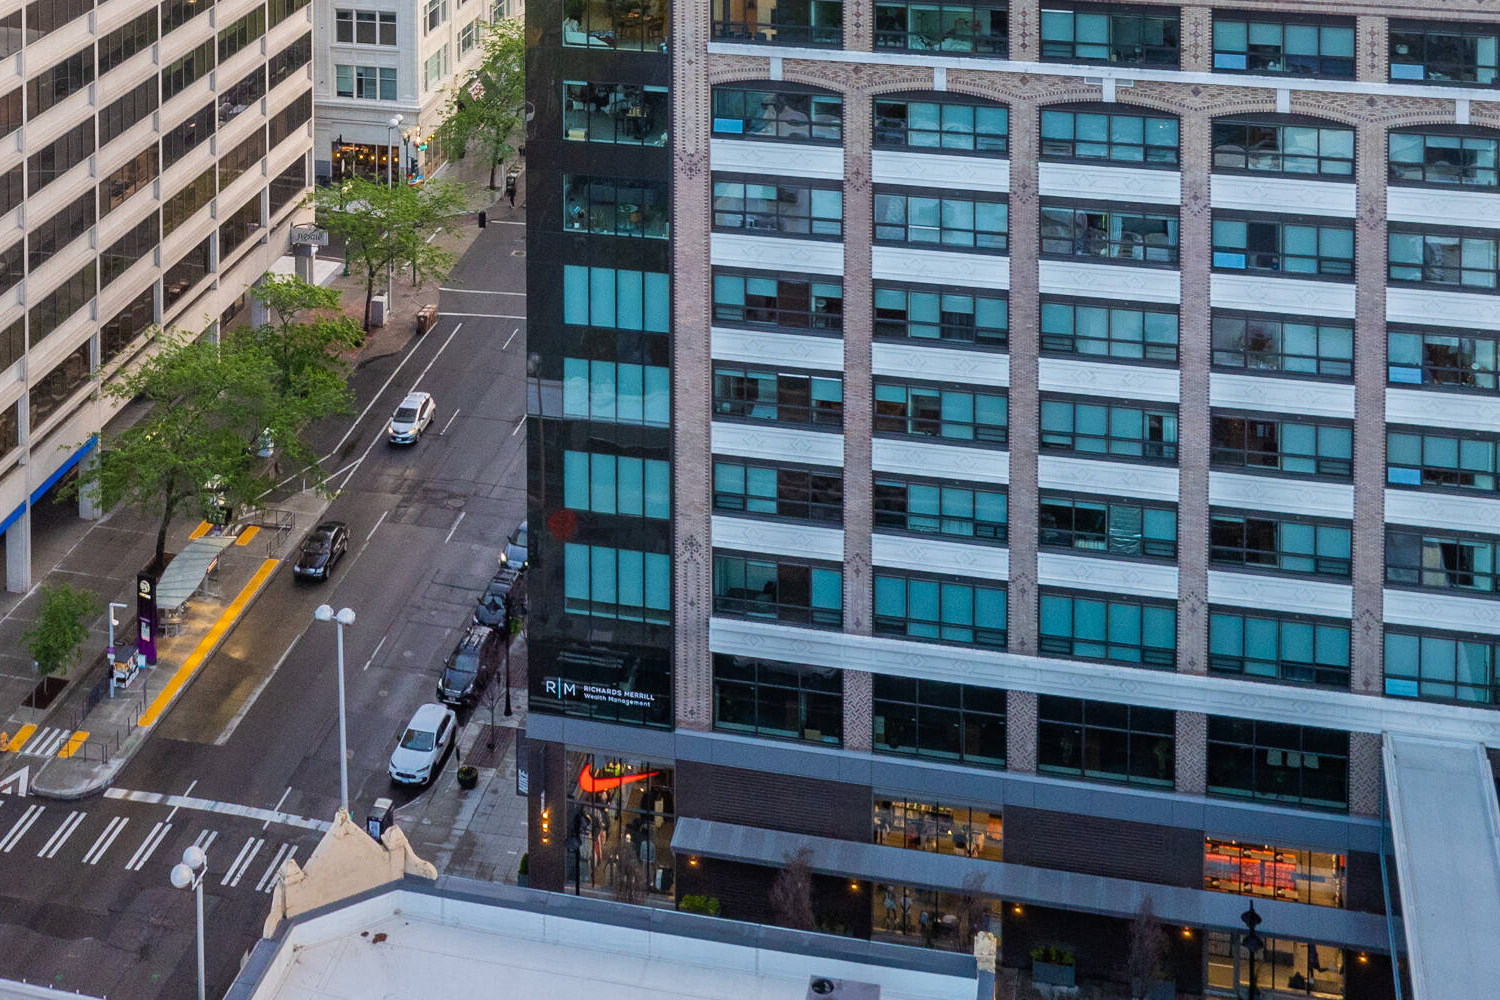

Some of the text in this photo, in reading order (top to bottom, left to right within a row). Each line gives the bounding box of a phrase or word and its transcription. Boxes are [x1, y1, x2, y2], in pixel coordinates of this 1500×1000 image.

[583, 685, 622, 697] RICHARDS
[624, 690, 655, 701] MERRILL
[583, 692, 651, 708] Wealth Management
